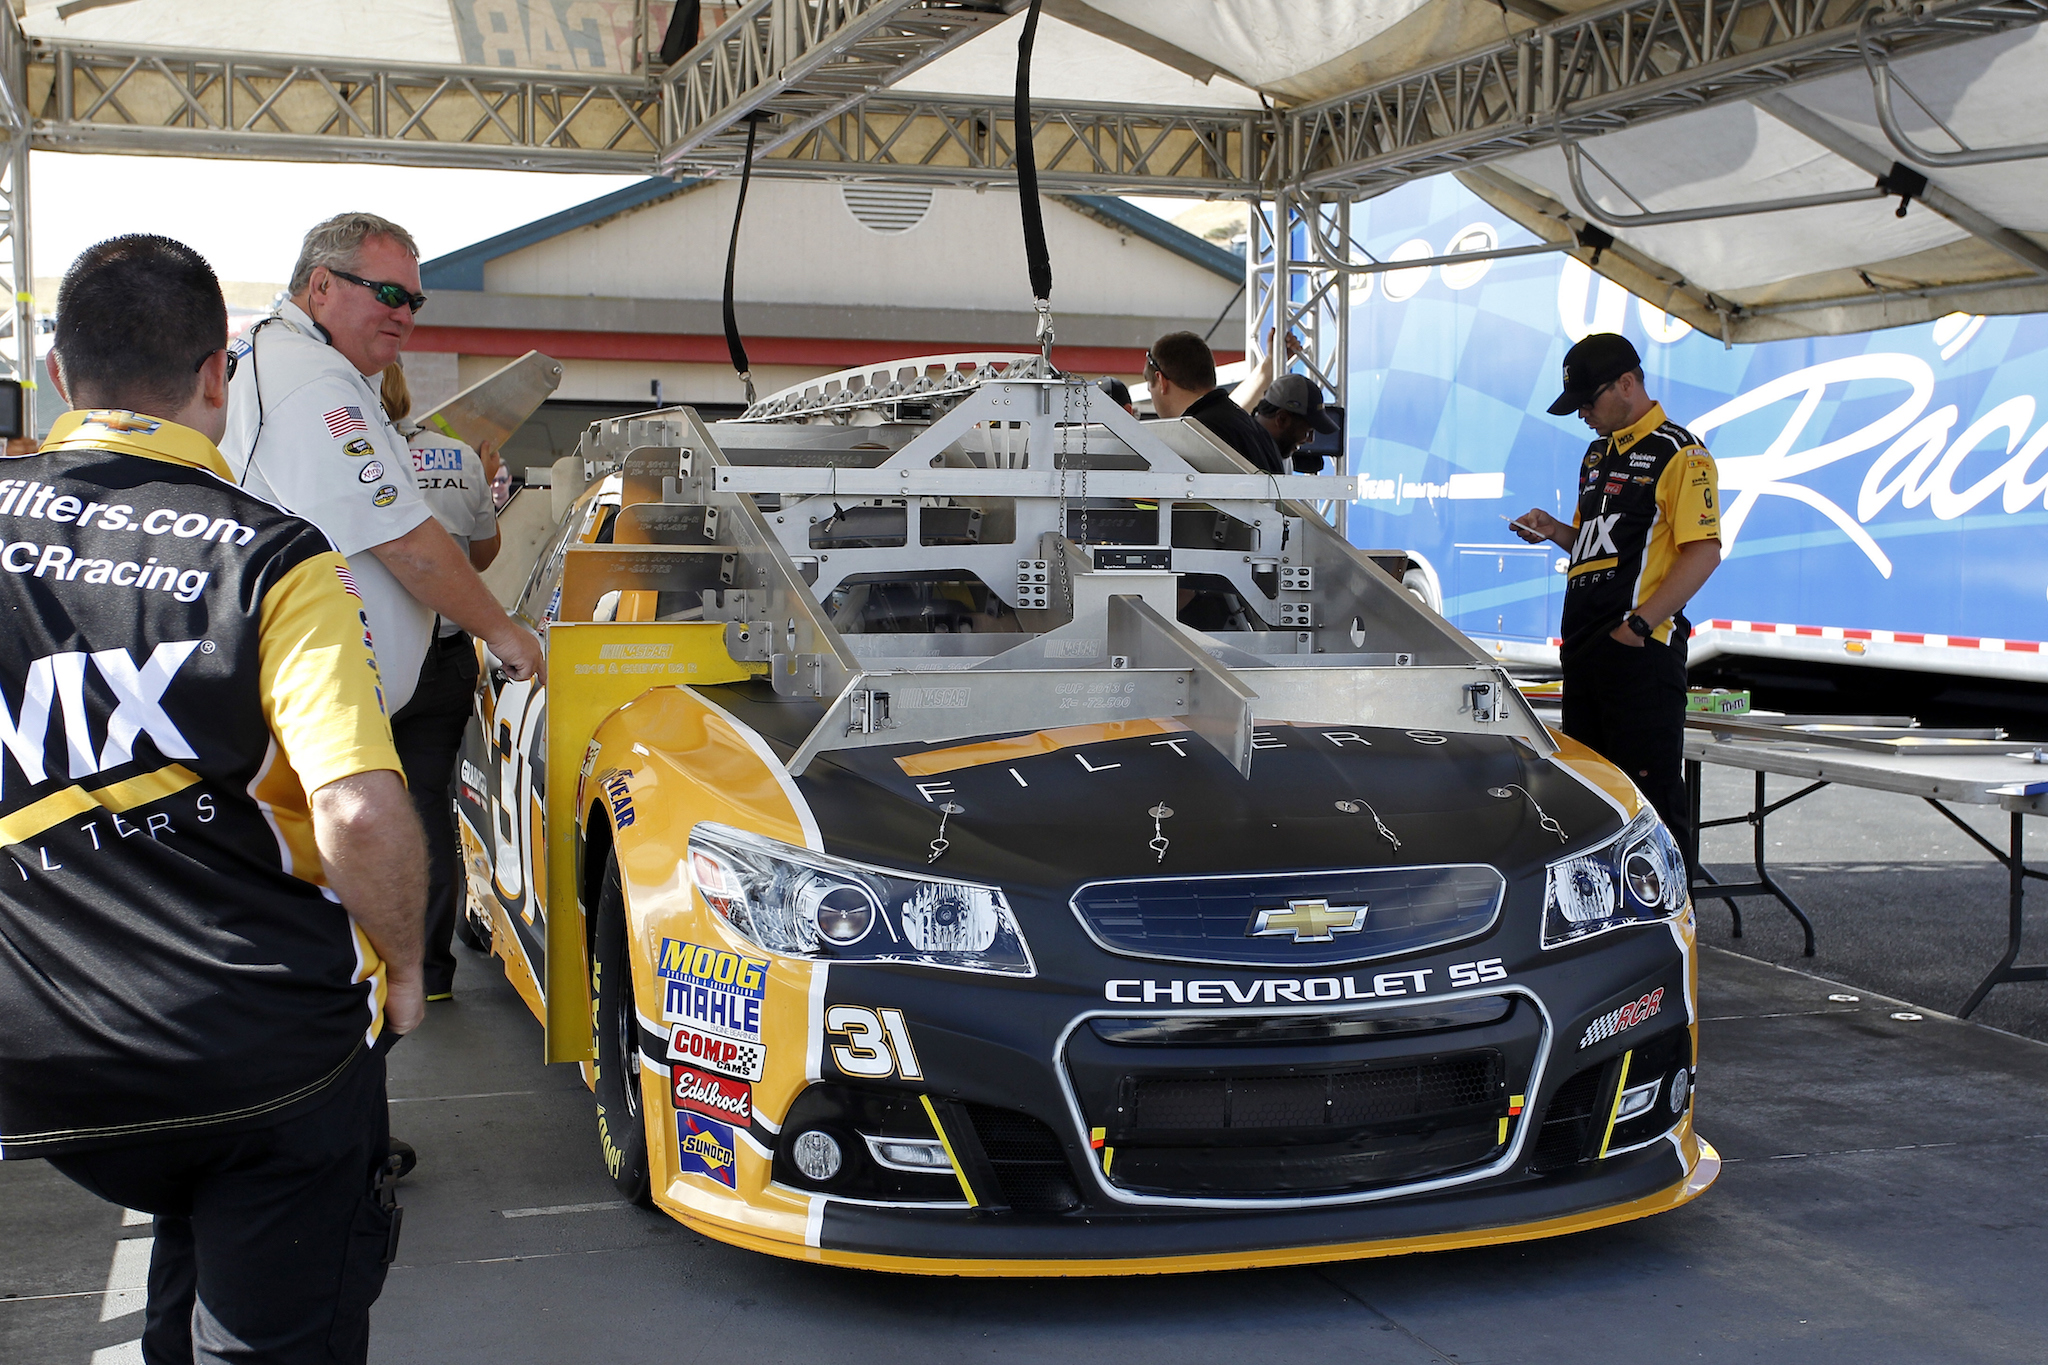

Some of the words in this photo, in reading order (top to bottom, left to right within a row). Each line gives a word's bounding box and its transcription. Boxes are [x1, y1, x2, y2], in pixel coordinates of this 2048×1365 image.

[1629, 452, 1656, 462] Quicken
[1629, 460, 1651, 469] Loans
[621, 644, 669, 658] NASCAR
[621, 663, 665, 674] CHEVY
[919, 688, 968, 708] NASCAR
[1055, 683, 1084, 695] CUP
[1087, 683, 1120, 694] 2013
[1124, 682, 1136, 694] C
[1082, 697, 1131, 708] -72.500
[661, 940, 767, 990] MOOG
[666, 970, 699, 985] STEERING
[711, 981, 754, 997] SUSPENSION
[1104, 968, 1434, 1003] CHEVROLET
[1448, 957, 1508, 988] SS
[666, 980, 759, 1033] MAHLE
[1612, 986, 1664, 1035] RCR
[711, 1024, 730, 1035] ENGINE
[730, 1028, 759, 1042] BEARINGS
[825, 1003, 924, 1081] 31
[674, 1030, 737, 1062] COMP
[716, 1060, 750, 1076] CAMS
[676, 1072, 749, 1117] Edelbrock
[685, 1137, 733, 1166] SUNOCO
